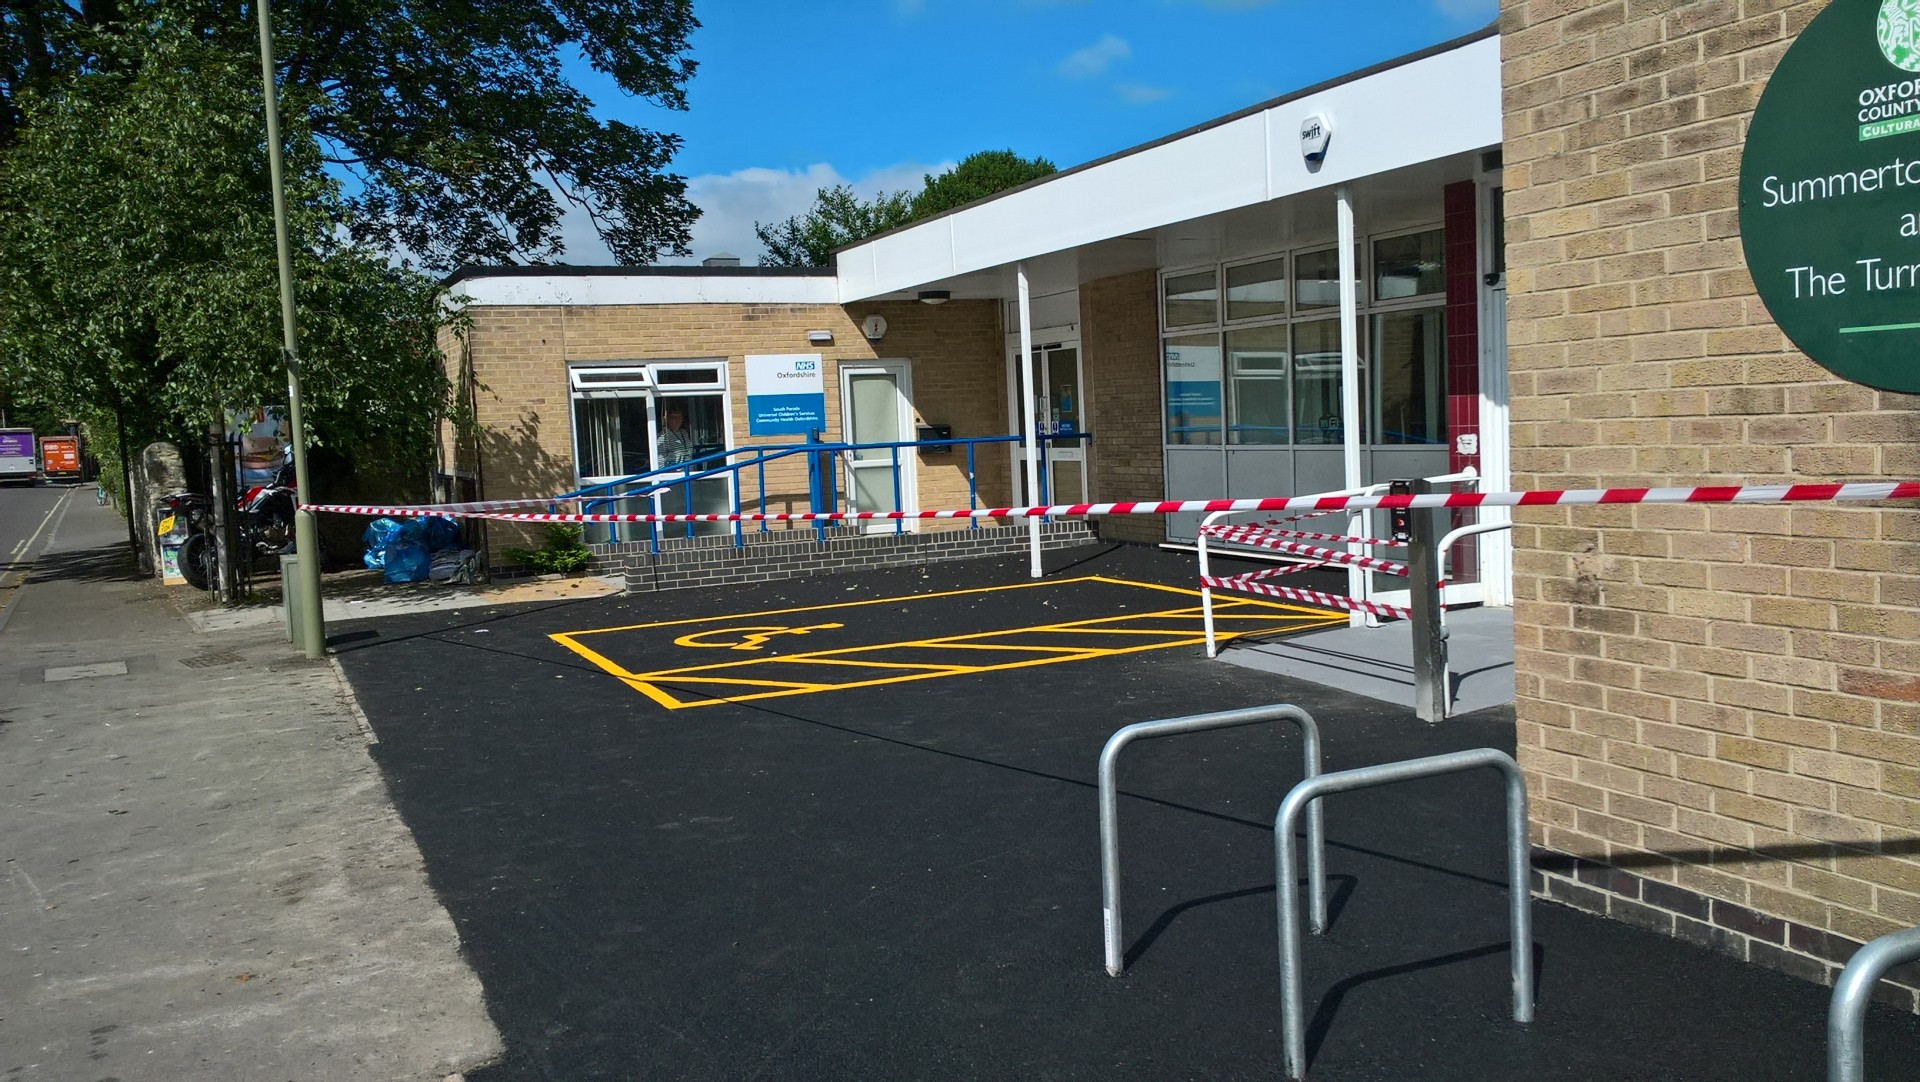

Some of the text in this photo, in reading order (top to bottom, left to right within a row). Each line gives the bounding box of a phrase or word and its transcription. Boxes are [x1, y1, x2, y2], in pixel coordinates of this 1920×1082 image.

[1302, 123, 1320, 140] swift
[1900, 212, 1920, 237] a
[1785, 265, 1846, 299] The
[796, 361, 815, 370] NHS
[777, 371, 816, 379] Oxfordshire
